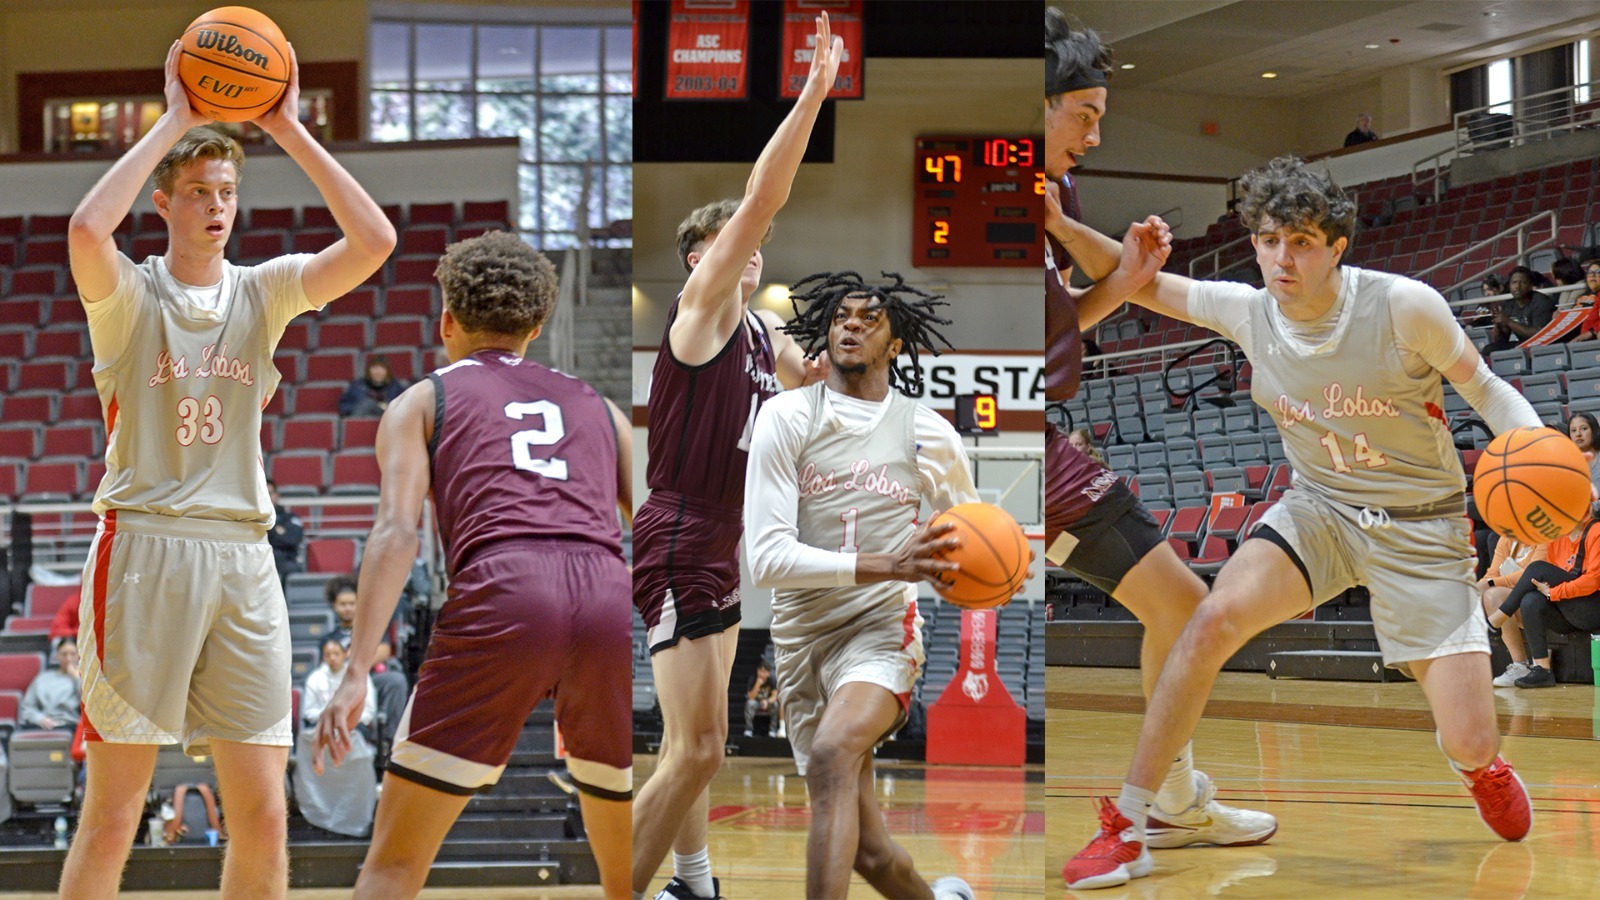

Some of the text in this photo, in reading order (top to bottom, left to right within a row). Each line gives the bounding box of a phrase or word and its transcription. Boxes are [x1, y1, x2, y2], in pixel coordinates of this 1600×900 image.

[197, 29, 269, 71] Wilson
[673, 49, 742, 63] CHAMPIONS
[696, 34, 720, 48] ASC
[674, 75, 737, 91] 2003-04
[926, 155, 961, 182] 47
[984, 139, 1033, 167] 10:3
[934, 221, 949, 243] 2
[148, 343, 254, 388] Los Lobos
[900, 365, 956, 399] SS
[175, 395, 224, 447] 33
[976, 396, 997, 428] 9
[1274, 381, 1400, 429] Los Lobos
[504, 399, 568, 480] 2
[1320, 431, 1387, 474] 14
[798, 458, 909, 505] Los Lobos
[839, 507, 859, 553] 1
